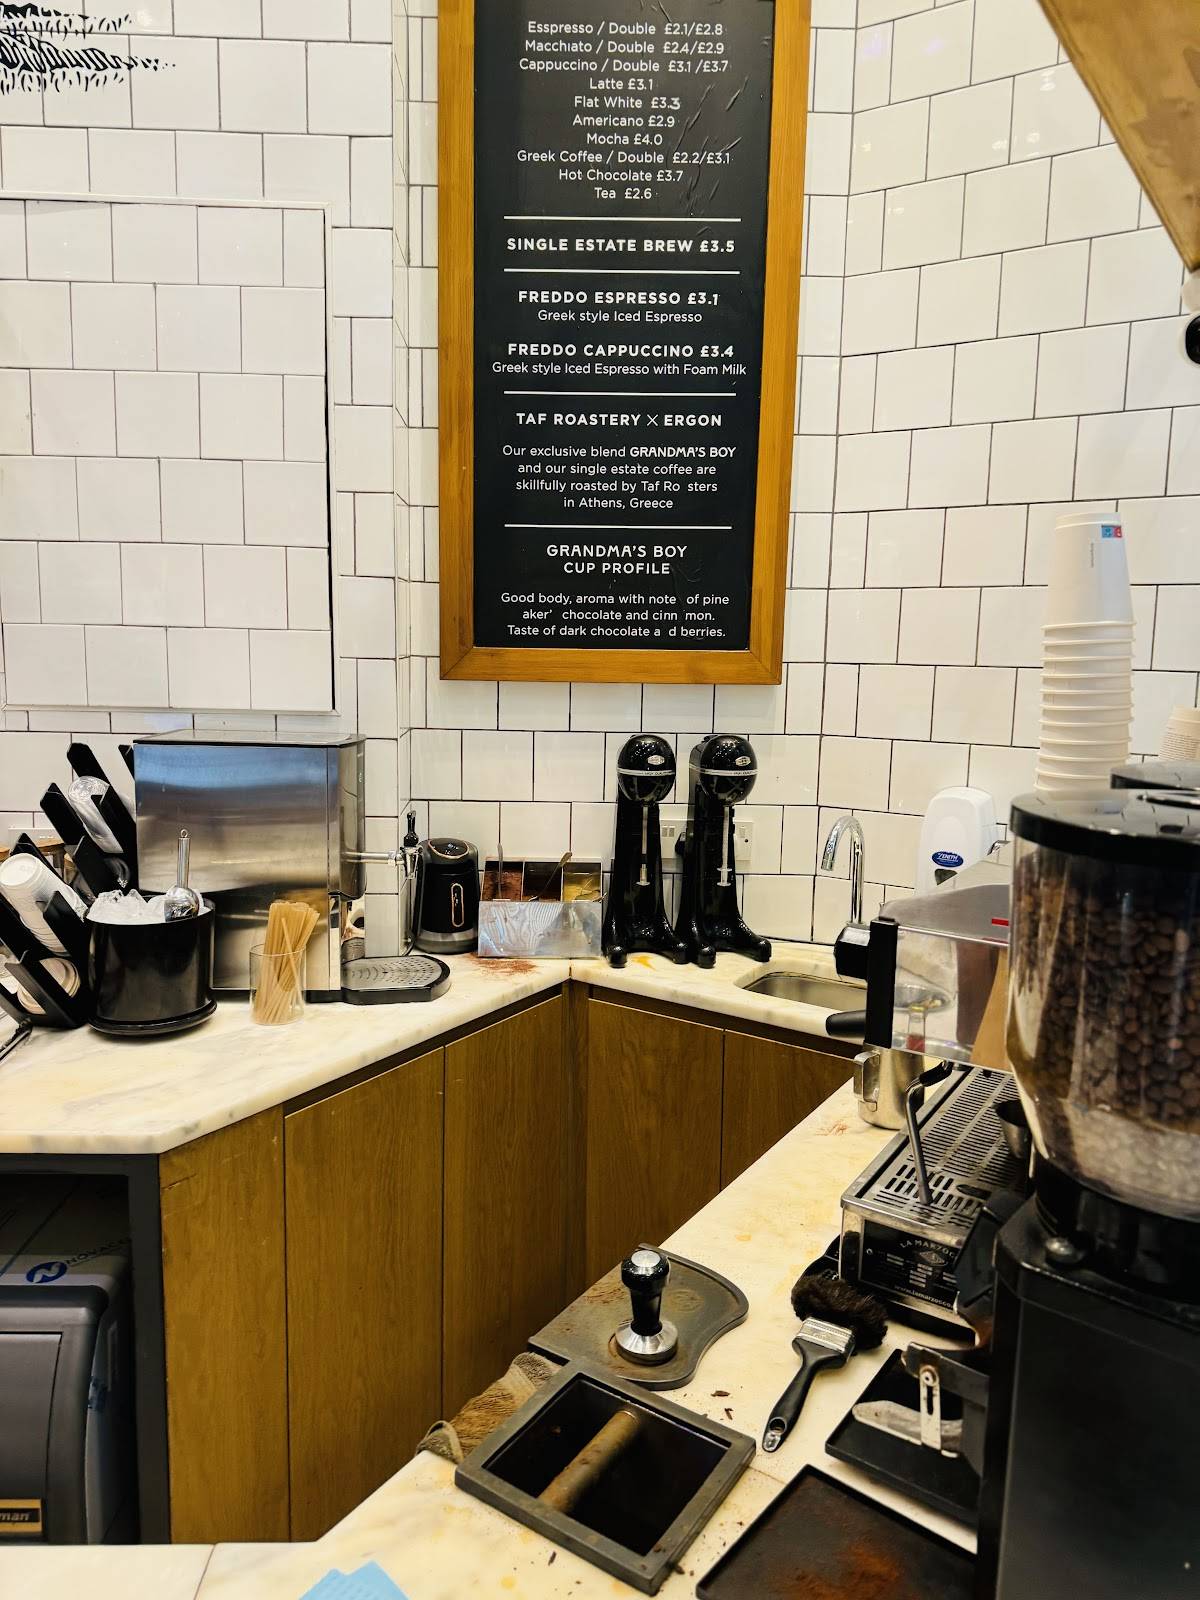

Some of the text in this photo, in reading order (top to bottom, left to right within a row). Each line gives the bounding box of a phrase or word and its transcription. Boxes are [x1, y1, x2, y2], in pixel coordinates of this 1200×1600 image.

[528, 22, 593, 35] Esspresso
[609, 23, 656, 34] Double
[526, 40, 592, 52] Macchiato
[608, 42, 655, 53] Double
[519, 59, 597, 72] Cappuccino
[613, 60, 660, 71] Double
[590, 77, 653, 91] Latte £3.1
[575, 96, 681, 110] Flat White £3.3
[573, 114, 675, 127] Americano £2.9
[587, 133, 662, 145] Mocha £4.0
[517, 150, 555, 162] Greek
[560, 151, 602, 162] Coffee
[618, 151, 664, 163] Double
[559, 169, 683, 181] Hot Chocolate £3.7
[594, 187, 652, 199] Tea £2.6
[507, 238, 734, 252] SINGLE ESTATE BREW £3.5
[519, 291, 718, 305] FREDDO ESPRESSO £3.1
[538, 310, 702, 323] Greek style Iced Espresso
[509, 344, 733, 357] FREDDO CAPPUCCINO £3.4
[493, 362, 746, 376] Greek style Iced Espresso with Foam Milk
[516, 413, 546, 424] TAF
[554, 414, 641, 425] ROASTERY
[664, 415, 721, 426] ERGON
[503, 445, 736, 457] Our exclusive blend GRANDMA'S BOY
[518, 463, 541, 473] and
[546, 465, 566, 473] our
[571, 463, 606, 475] single
[611, 464, 649, 474] estate
[653, 464, 692, 474] coffee
[516, 479, 566, 492] skillfully
[571, 481, 617, 491] roasted
[622, 481, 636, 493] by
[641, 481, 660, 491] Taf
[564, 497, 673, 509] in Athens, Greece
[547, 545, 687, 557] GRANDMA'S BOY
[564, 562, 669, 574] CUP PROFILE
[501, 593, 534, 602] Good
[539, 593, 571, 605] body,
[619, 594, 644, 603] with
[687, 594, 699, 604] of
[703, 594, 729, 606] pine
[562, 610, 622, 620] chocolate
[626, 610, 648, 620] and
[508, 625, 539, 635] Taste
[543, 625, 556, 635] of
[560, 626, 586, 635] dark
[591, 626, 650, 636] chocolate
[681, 626, 725, 636] berries.
